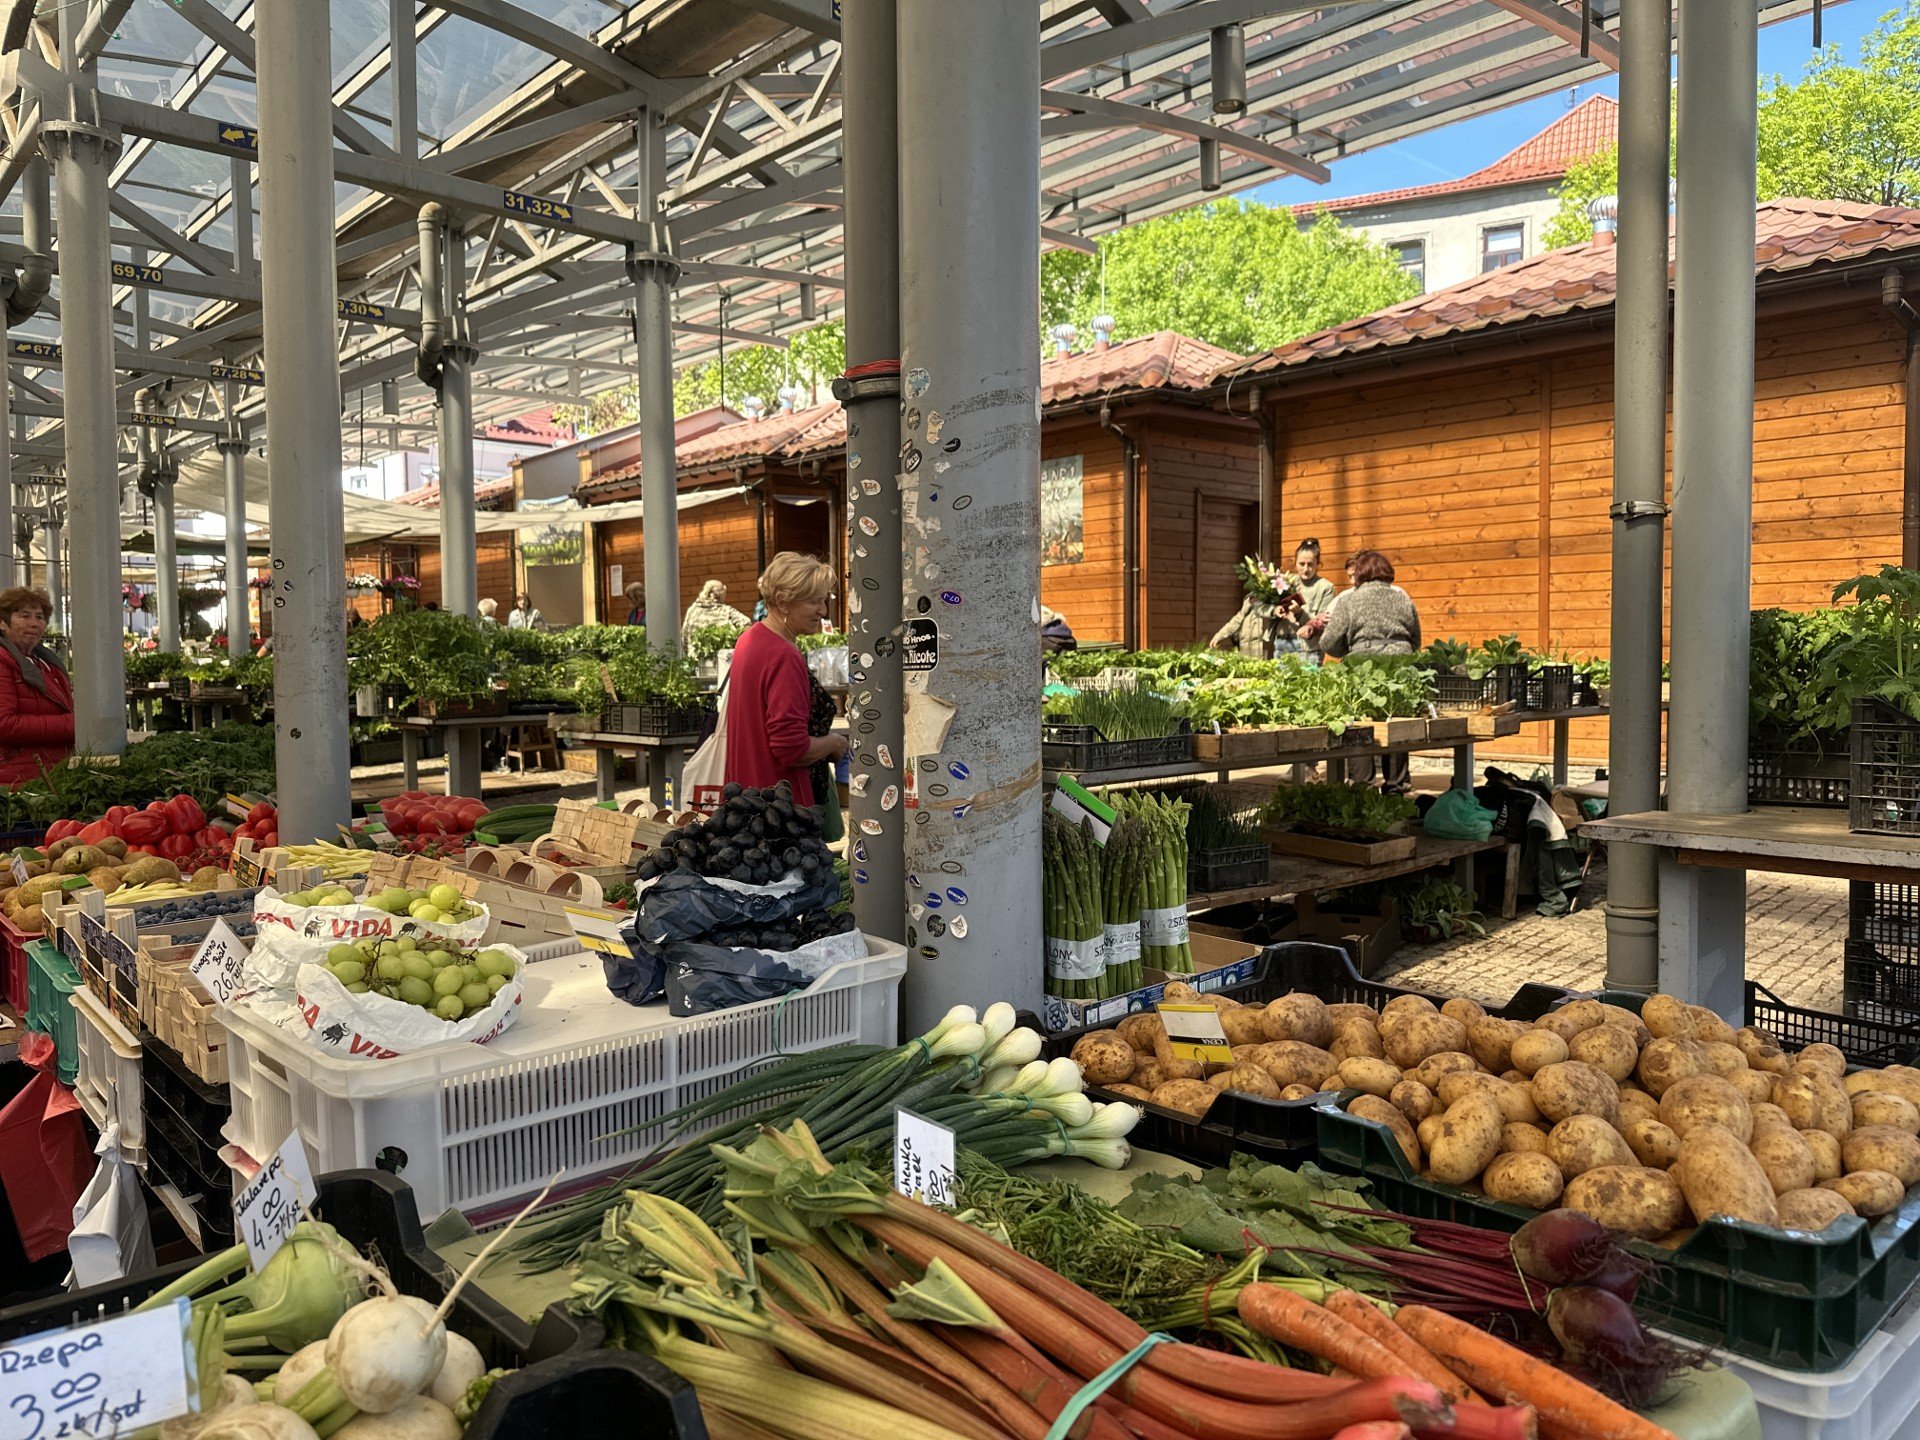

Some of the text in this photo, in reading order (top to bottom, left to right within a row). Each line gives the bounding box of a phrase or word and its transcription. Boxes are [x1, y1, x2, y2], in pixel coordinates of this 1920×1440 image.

[505, 193, 552, 217] 31,32
[112, 263, 162, 282] 69,70
[212, 366, 248, 380] 27,28
[331, 916, 393, 939] VIDA
